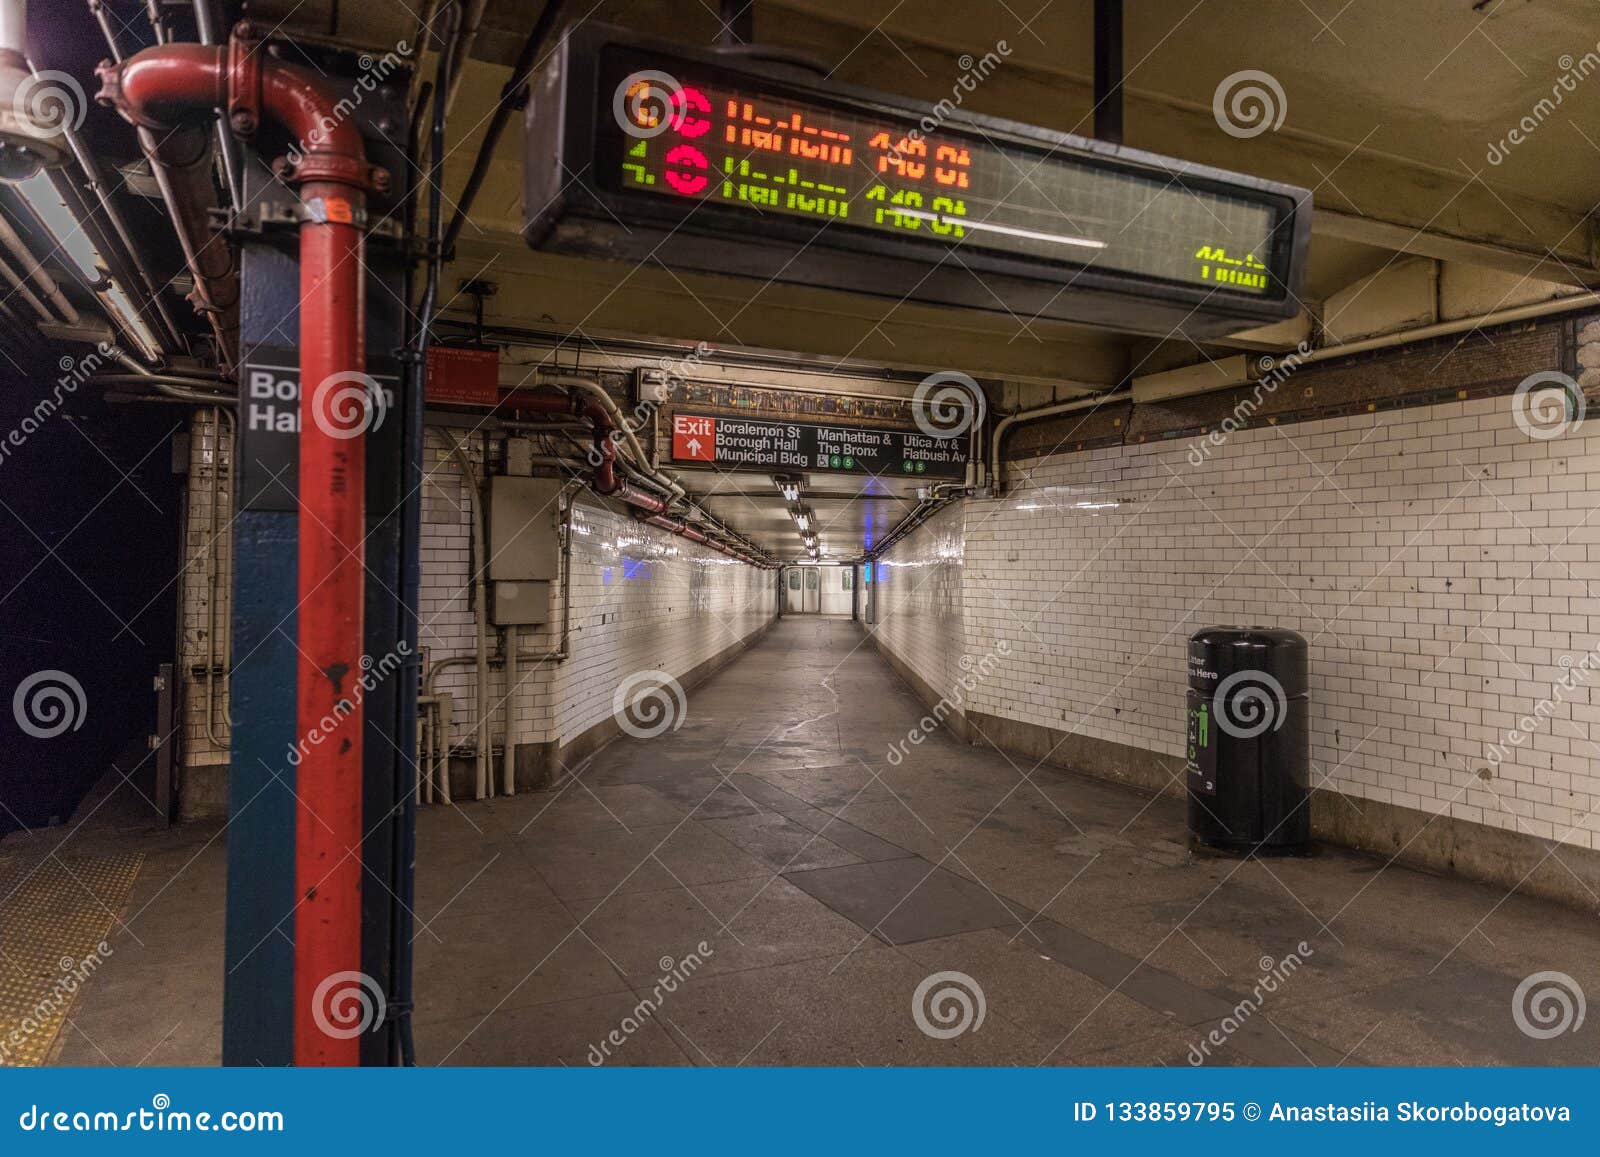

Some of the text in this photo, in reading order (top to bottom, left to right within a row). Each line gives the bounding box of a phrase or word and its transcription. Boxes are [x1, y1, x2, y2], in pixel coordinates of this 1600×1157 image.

[674, 417, 711, 436] Exit
[716, 421, 801, 439] Joralemon St
[716, 434, 798, 451] Borough Hall
[817, 428, 892, 446] Manhattan &
[903, 435, 959, 450] Utica Av &
[716, 448, 808, 467] Municipal Bldg
[817, 442, 878, 457] The Bronx
[903, 448, 966, 463] Flatbush Av
